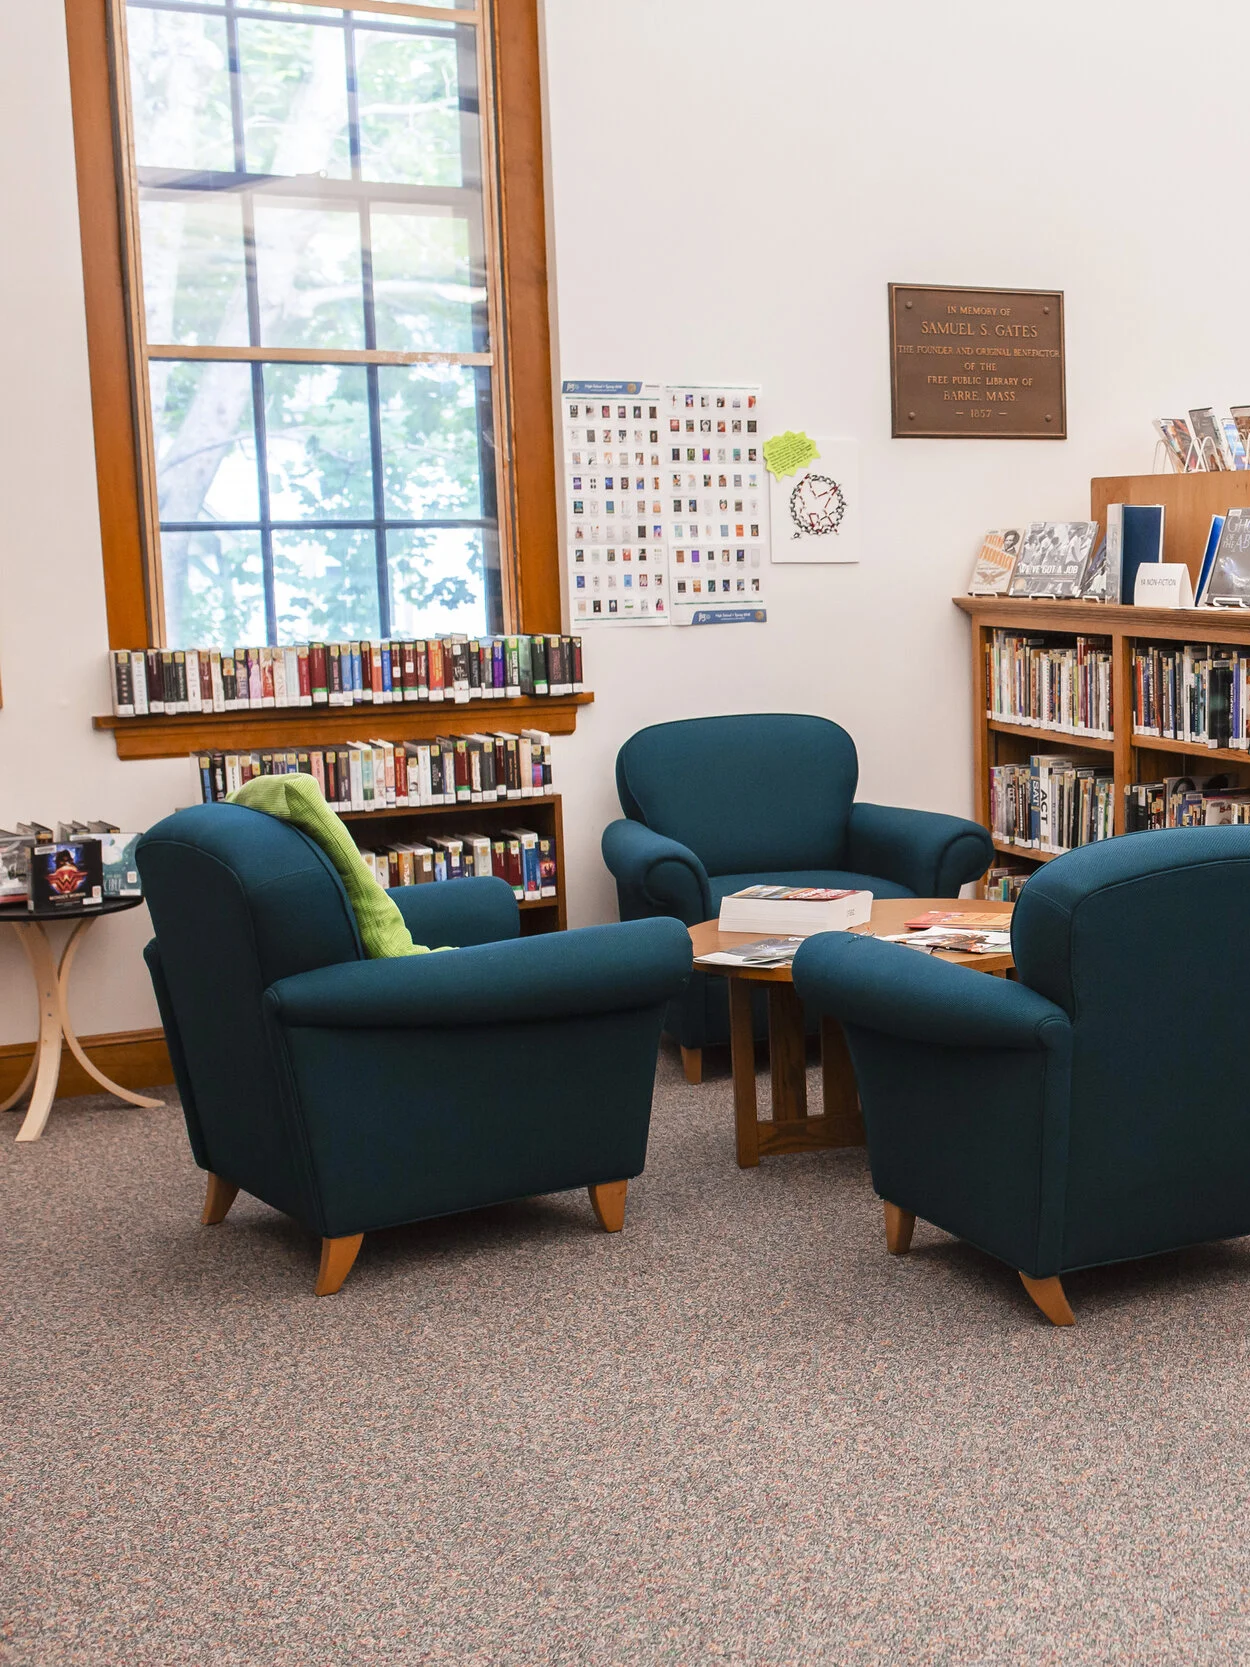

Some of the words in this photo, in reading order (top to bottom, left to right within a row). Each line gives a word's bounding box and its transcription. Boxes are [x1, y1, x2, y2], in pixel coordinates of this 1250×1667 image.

[947, 305, 957, 314] IN
[960, 305, 997, 316] MEMORY
[1000, 308, 1011, 316] OF
[921, 321, 975, 336] SAMUEL
[980, 323, 991, 336] S.
[995, 325, 1038, 338] GATES
[897, 344, 914, 354] THE
[916, 345, 953, 355] FOUNDER
[955, 346, 973, 356] AND
[975, 347, 1011, 357] ORIGINAL
[1013, 348, 1061, 358] BENEFACTOR
[964, 362, 975, 371] OF
[980, 362, 997, 371] THE
[927, 375, 949, 384] FREE
[952, 376, 981, 385] PUBLIC
[986, 376, 1019, 386] LIBRARY
[1022, 377, 1033, 386] OF
[970, 409, 992, 418] 1857
[1018, 564, 1041, 573] WE'VE
[1042, 565, 1056, 573] GOT
[1057, 565, 1062, 573] A
[1063, 565, 1078, 573] JOB
[1032, 780, 1040, 806] SAT
[1040, 789, 1048, 824] ACT
